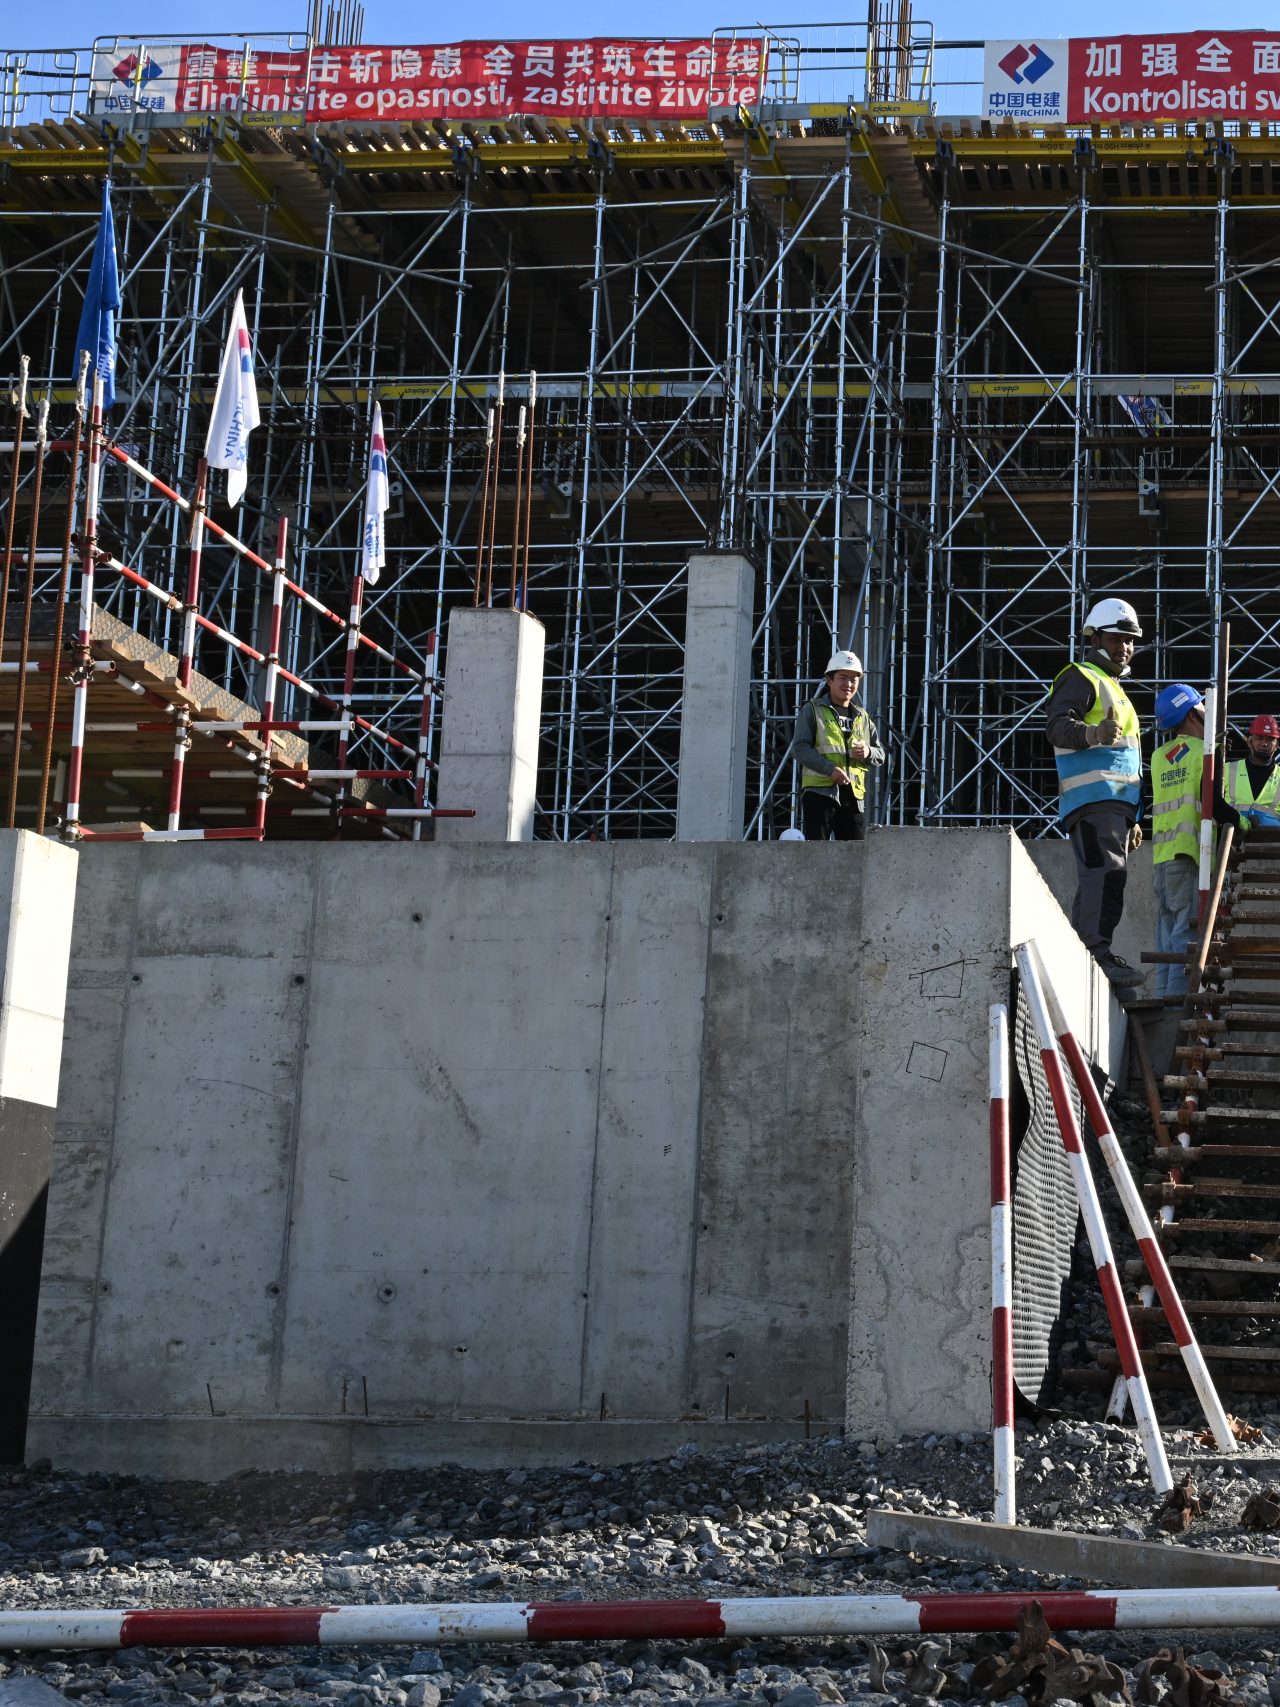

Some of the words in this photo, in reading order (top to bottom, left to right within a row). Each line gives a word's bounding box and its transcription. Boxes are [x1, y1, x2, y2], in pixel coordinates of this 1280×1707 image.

[483, 44, 759, 78] 全员共筑生命线
[355, 79, 513, 115] opasnosti,
[522, 79, 651, 106] zaštitite
[660, 79, 757, 107] živote
[872, 104, 901, 112] doka
[989, 91, 1061, 109] 中国电建
[1084, 79, 1247, 113] Kontrolisati
[988, 108, 1060, 117] POWERCHINA
